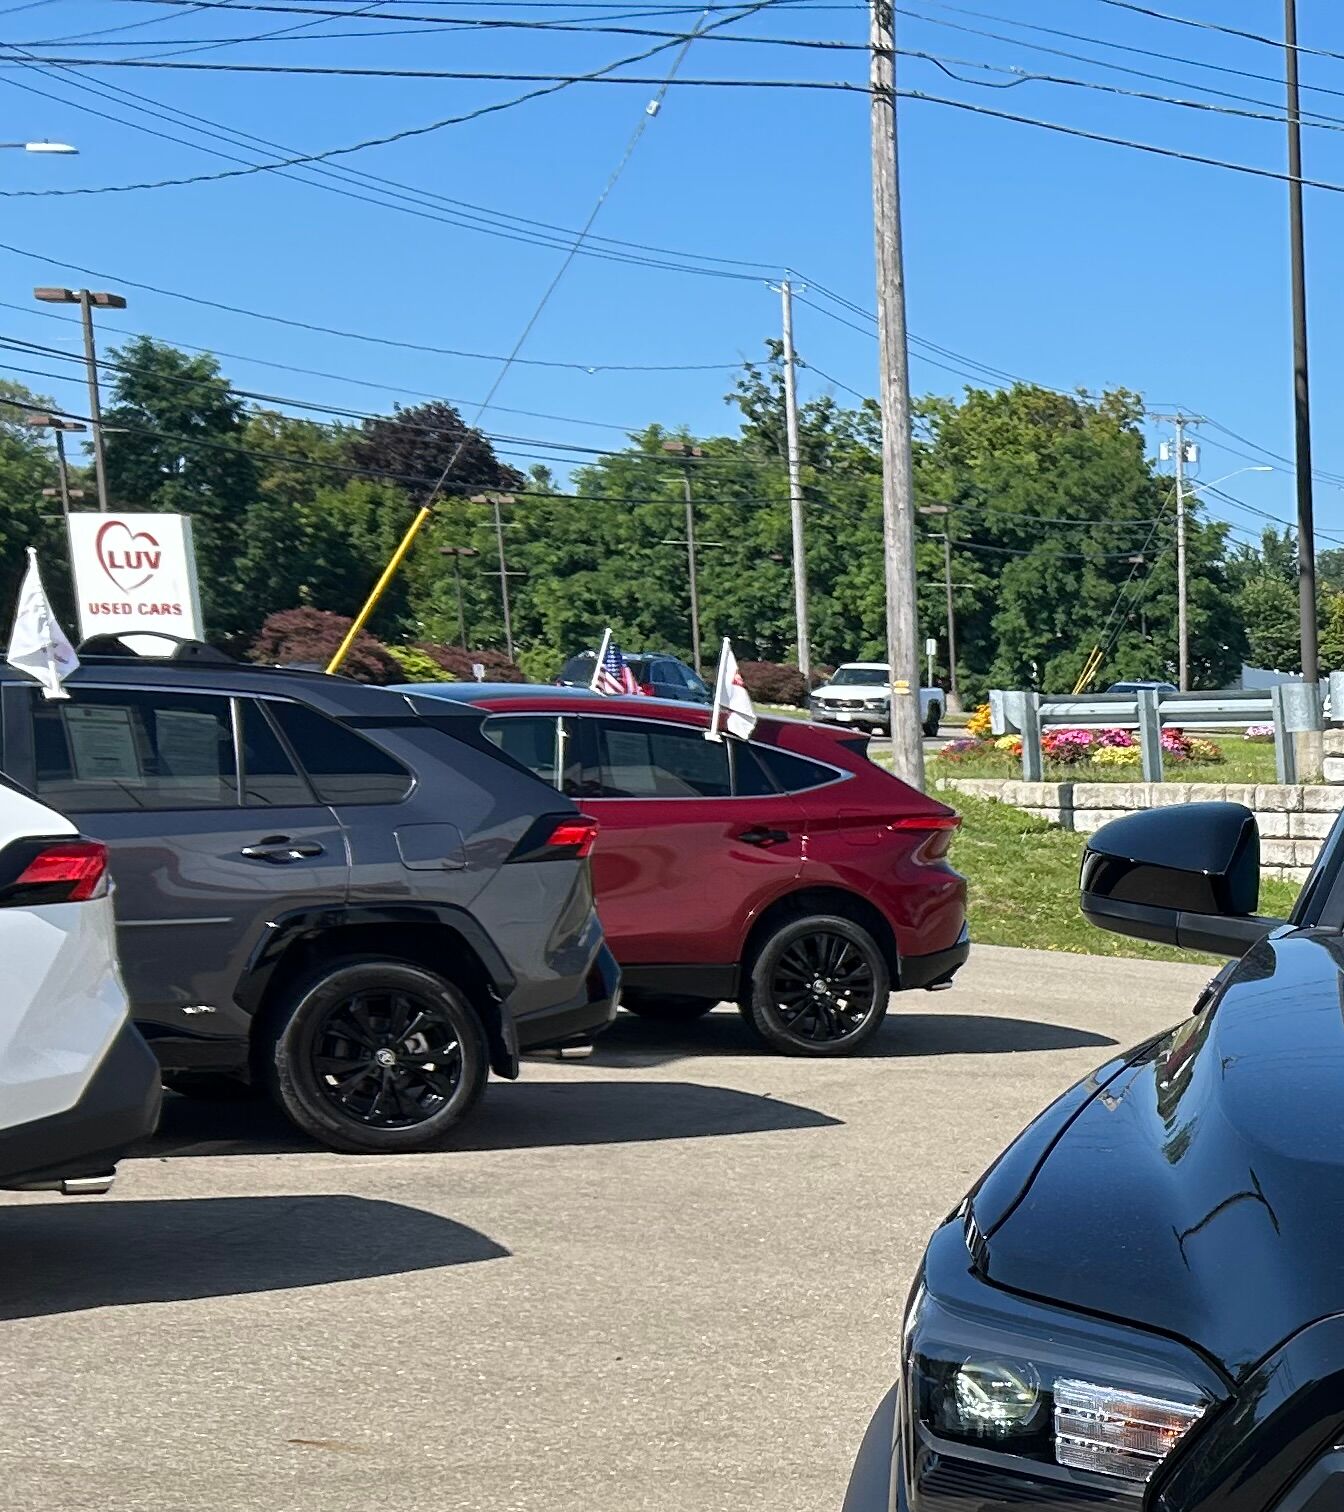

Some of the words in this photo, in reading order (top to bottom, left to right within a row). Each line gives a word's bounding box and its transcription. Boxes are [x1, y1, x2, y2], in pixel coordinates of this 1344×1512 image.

[107, 550, 161, 569] LUV
[88, 602, 132, 616] USED
[138, 602, 183, 616] CARS
